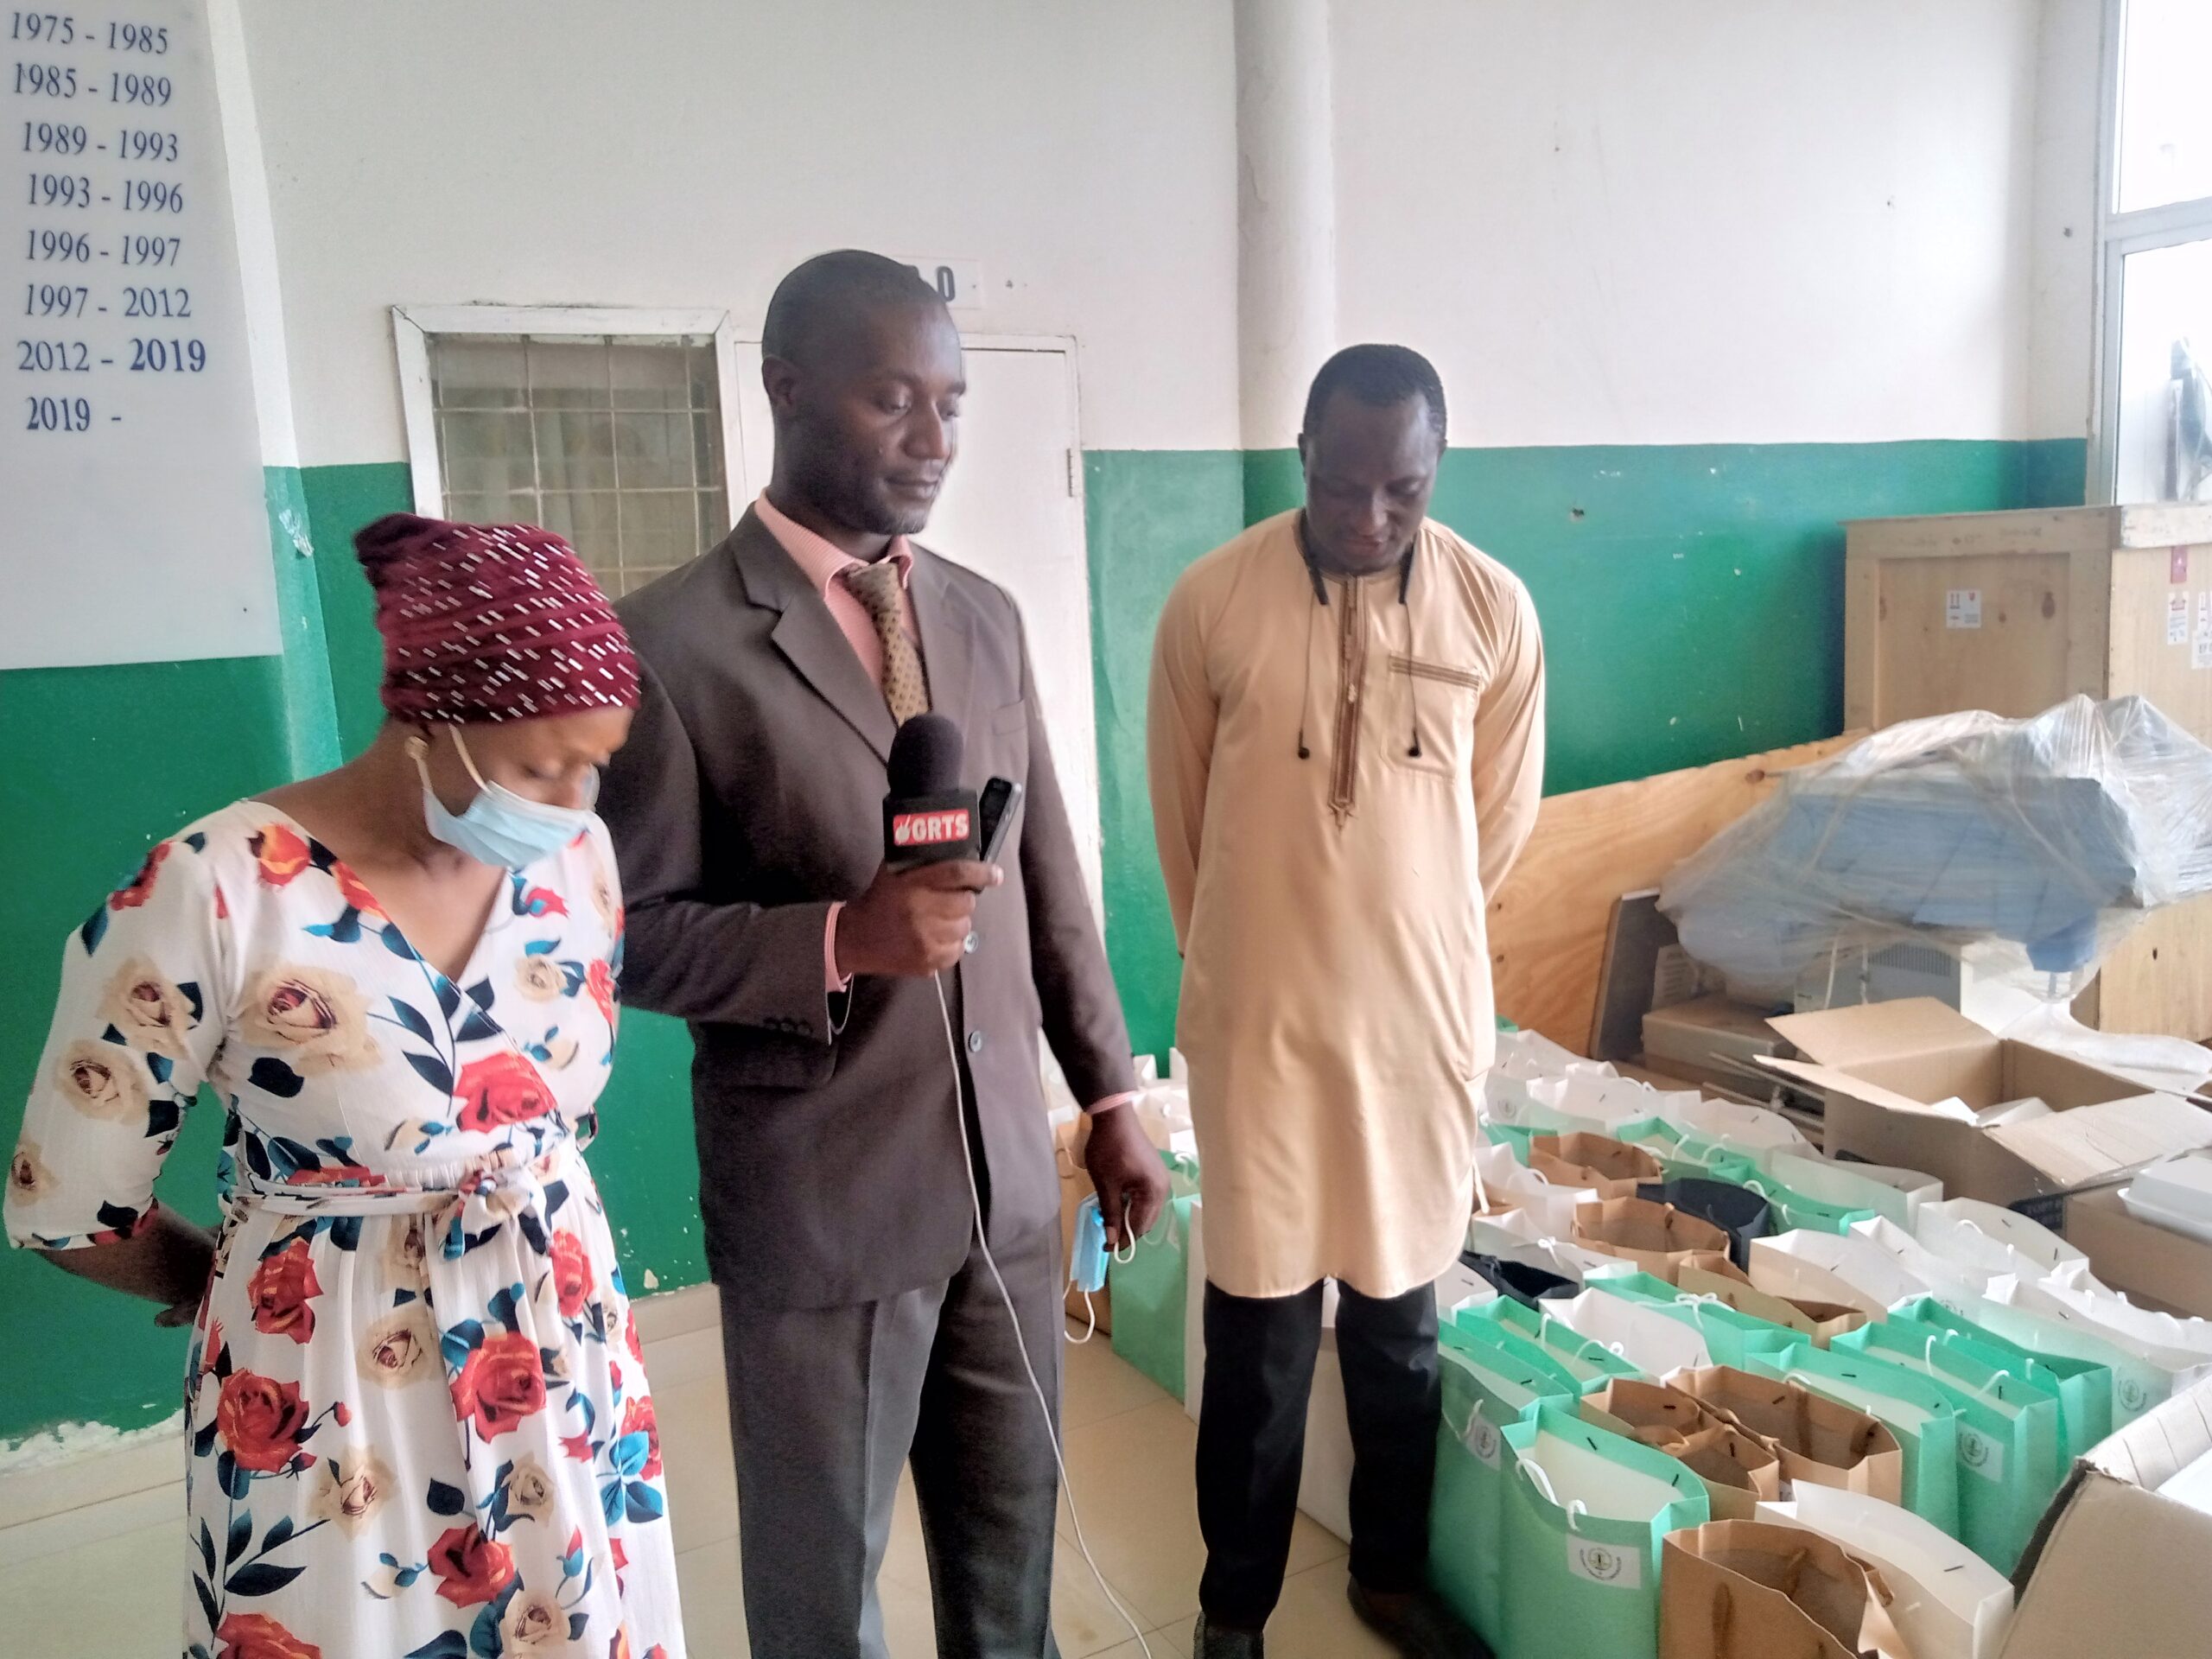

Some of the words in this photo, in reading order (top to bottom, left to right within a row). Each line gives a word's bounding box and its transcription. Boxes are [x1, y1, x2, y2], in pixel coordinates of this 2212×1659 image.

[11, 12, 74, 44] 1975
[108, 22, 168, 54] 1985
[14, 62, 77, 99] 1985
[111, 72, 172, 106] 1989
[22, 121, 87, 155] 1989
[119, 130, 179, 162] 1993
[29, 173, 91, 208] 1993
[124, 180, 184, 213] 1996
[27, 229, 91, 263] 1996
[121, 235, 181, 267] 1997
[24, 283, 89, 316] 1997
[123, 287, 192, 318] 2012
[17, 340, 91, 372] 2012
[129, 338, 207, 372] 2019
[26, 396, 92, 432] 2019
